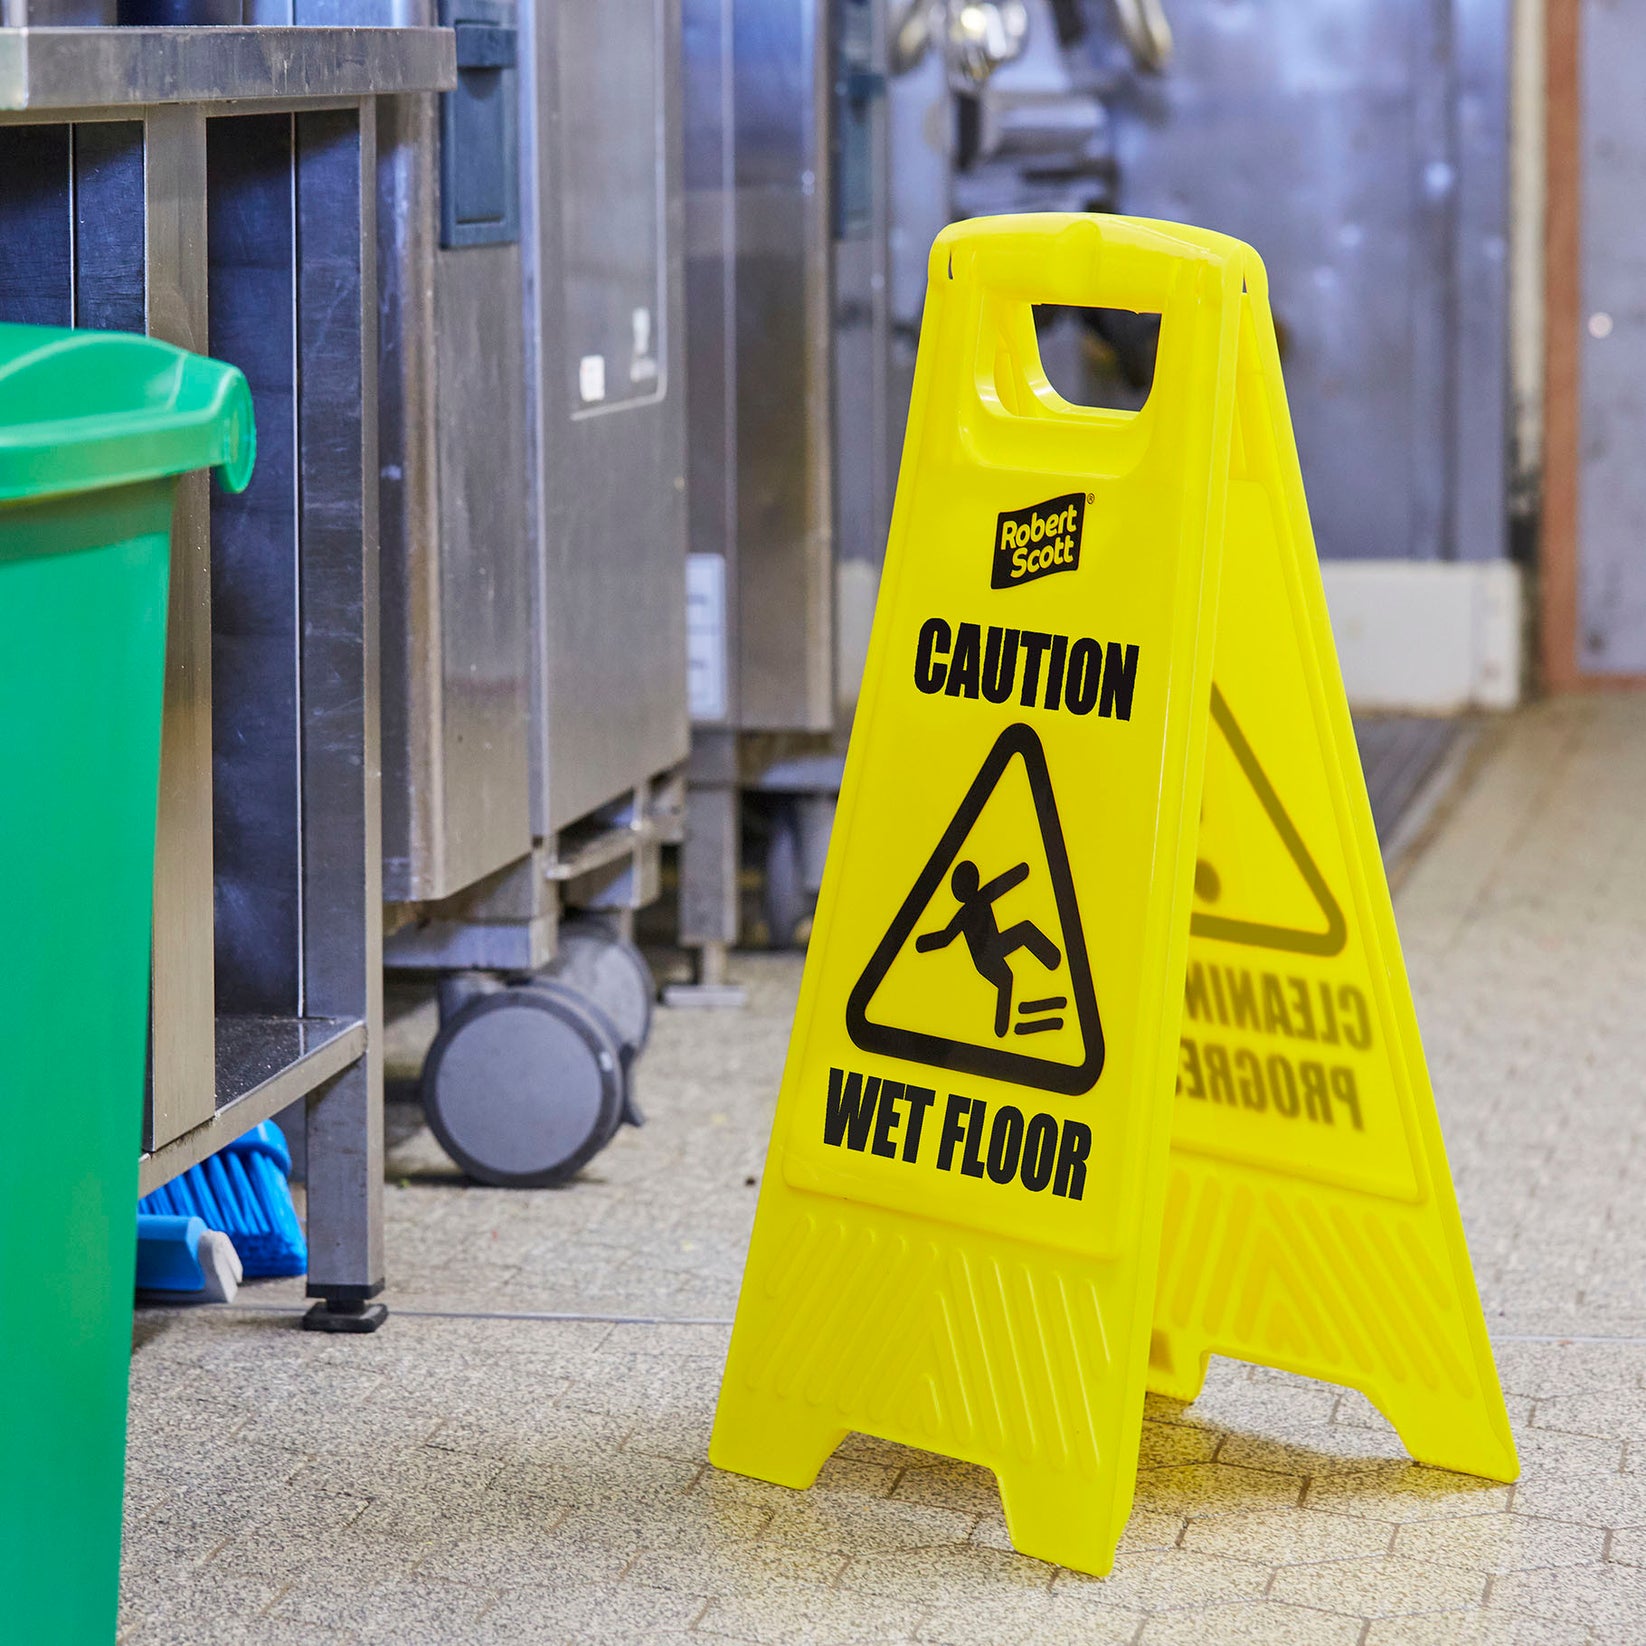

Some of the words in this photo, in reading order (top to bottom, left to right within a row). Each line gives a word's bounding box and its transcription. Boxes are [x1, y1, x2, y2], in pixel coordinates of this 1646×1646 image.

[1000, 504, 1078, 551] Robert
[1009, 534, 1075, 578] Scott
[914, 617, 1140, 722] CAUTION
[823, 1066, 936, 1164] WET
[936, 1093, 1092, 1202] FLOOR
